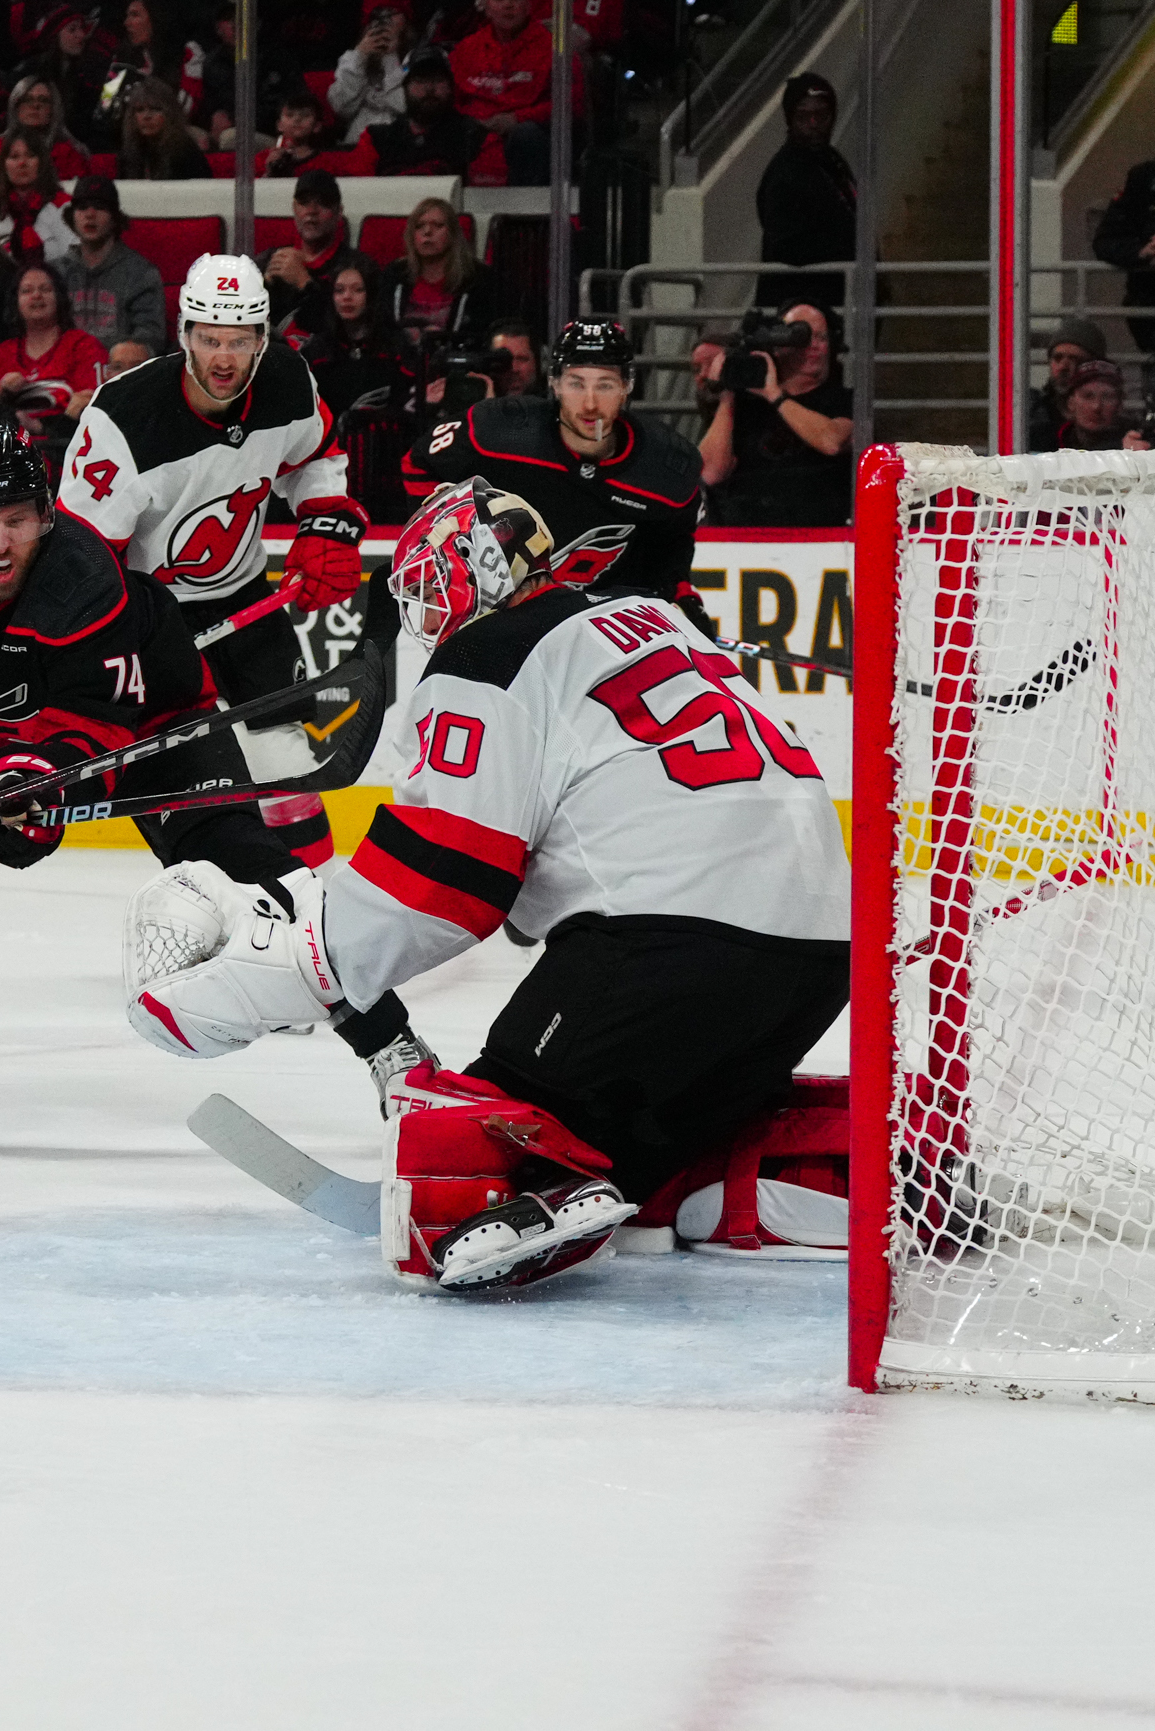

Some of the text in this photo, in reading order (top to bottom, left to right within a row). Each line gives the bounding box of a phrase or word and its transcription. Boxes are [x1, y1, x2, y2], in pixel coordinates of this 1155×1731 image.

[212, 303, 245, 311] CCM
[216, 277, 240, 291] 24
[298, 516, 360, 539] CCM
[588, 604, 688, 655] DAW
[103, 652, 145, 705] 74
[304, 920, 330, 990] TRUE
[534, 1012, 562, 1058] CCM
